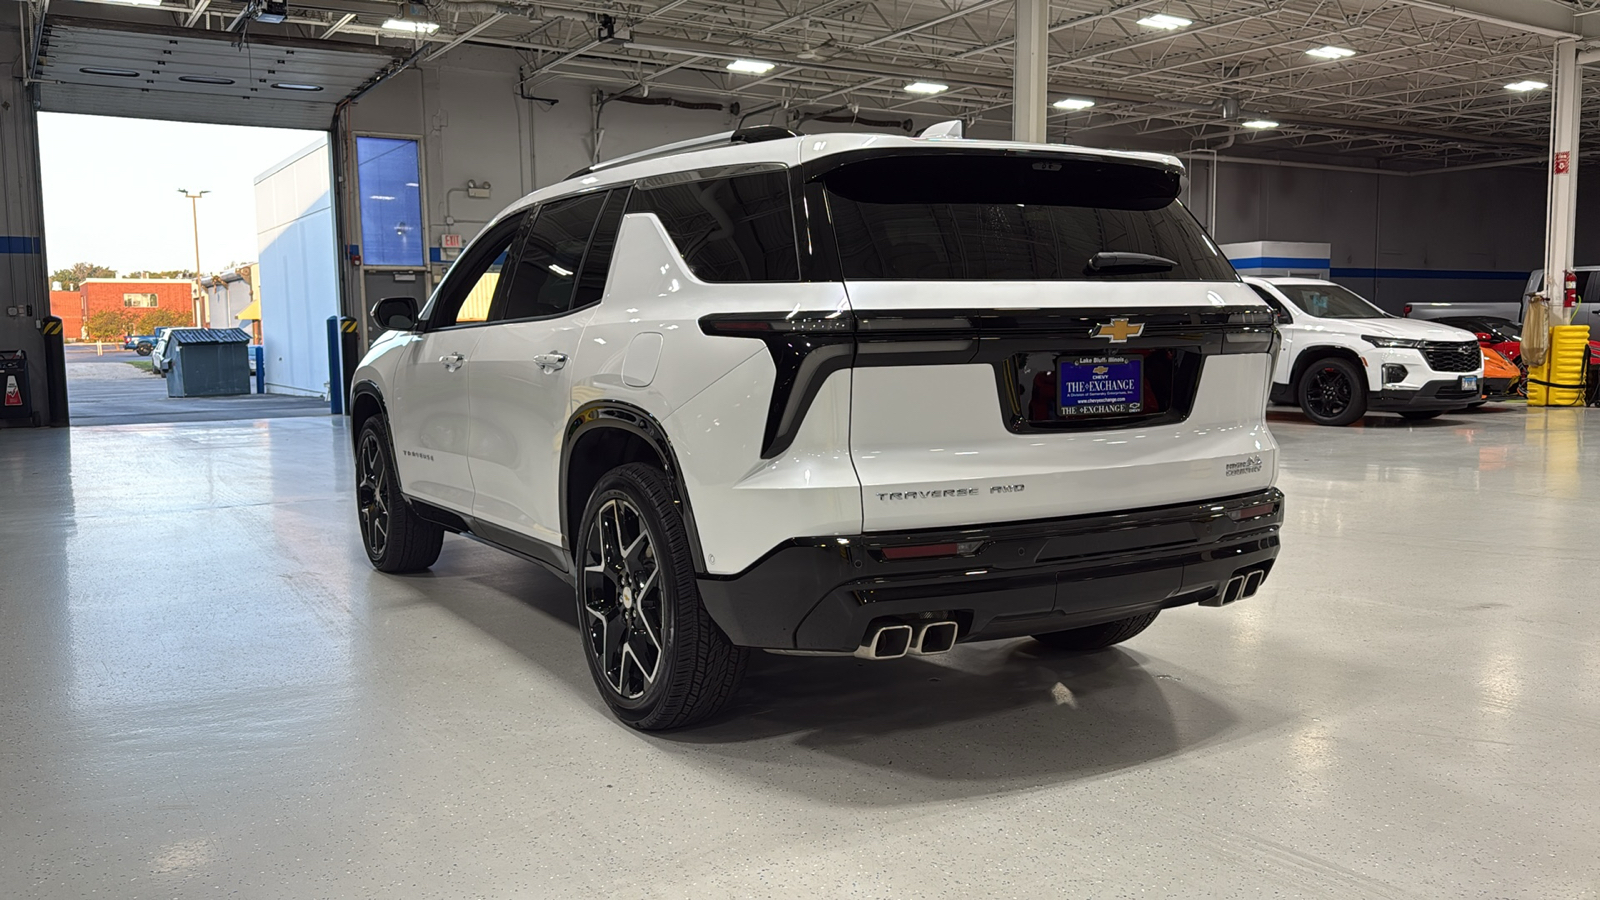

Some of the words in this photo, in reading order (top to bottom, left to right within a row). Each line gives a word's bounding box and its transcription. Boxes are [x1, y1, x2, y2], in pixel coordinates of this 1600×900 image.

[445, 235, 459, 246] EXIT
[1066, 382, 1085, 392] THE
[1089, 379, 1134, 391] EXCHANGE
[1061, 407, 1076, 415] THE
[1083, 405, 1125, 413] EXCHANGE
[876, 487, 979, 501] TRAVERSE
[990, 484, 1025, 494] AWD
